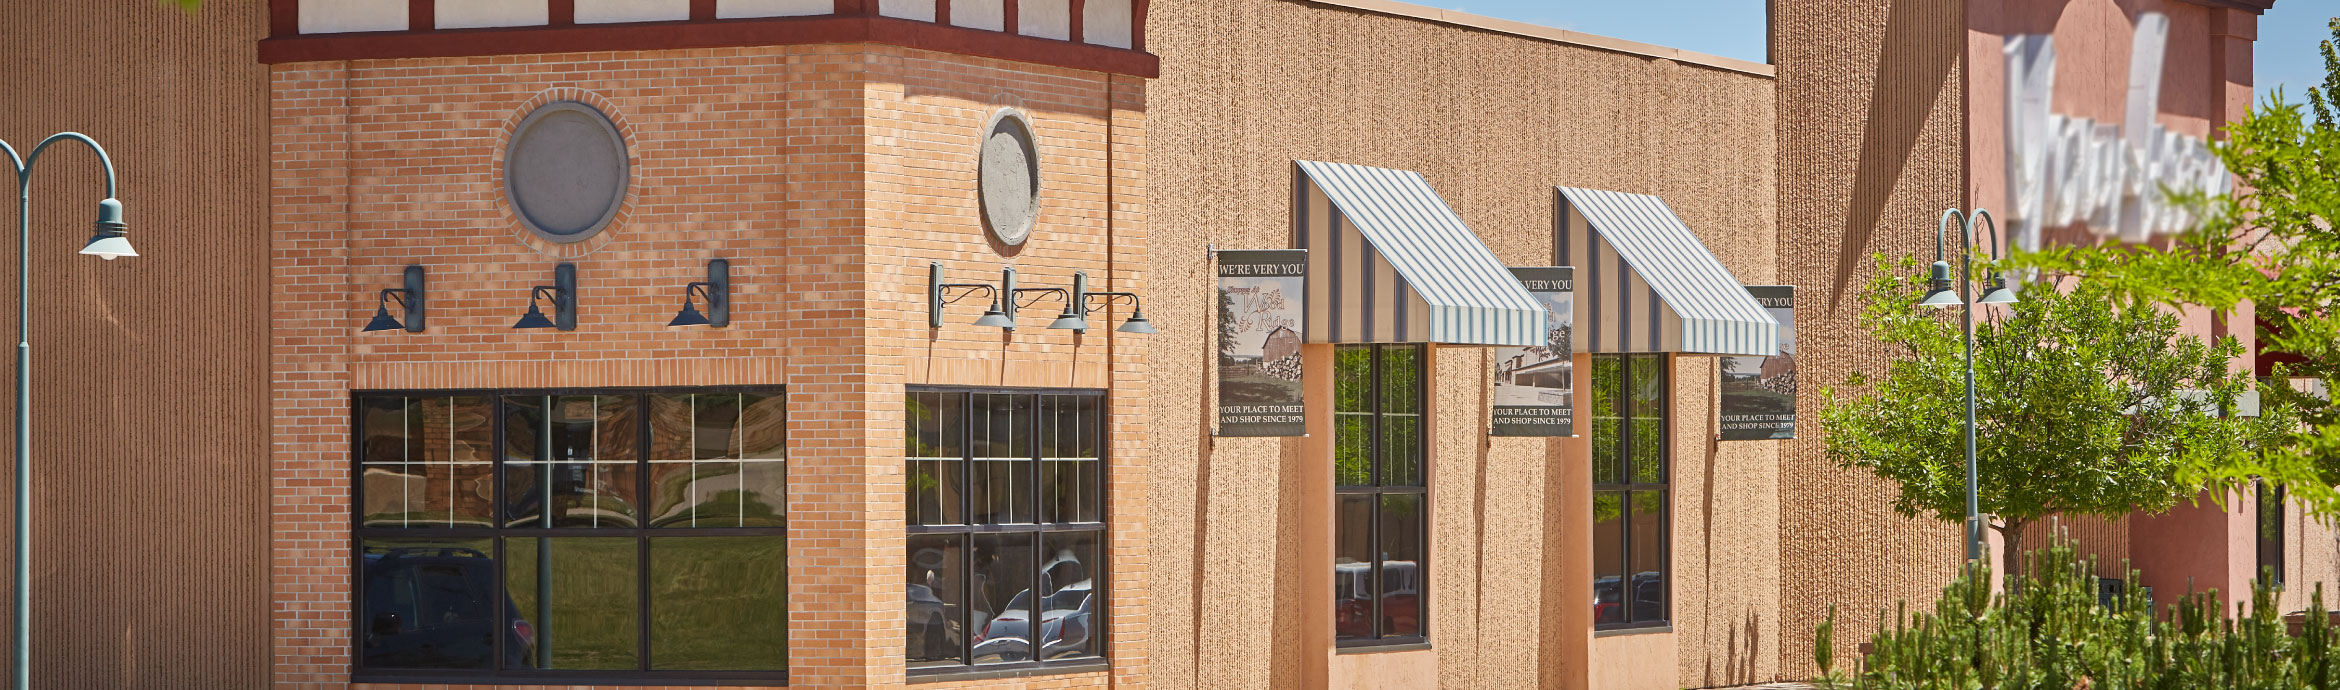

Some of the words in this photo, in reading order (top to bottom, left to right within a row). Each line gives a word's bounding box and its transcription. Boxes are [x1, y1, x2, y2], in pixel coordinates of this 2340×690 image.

[1219, 264, 1250, 274] WE'RE
[1253, 264, 1279, 274] VERY
[1282, 264, 1304, 274] YOU
[1525, 280, 1549, 289] VERY
[1552, 280, 1572, 289] YOU
[1774, 297, 1792, 306] YOU
